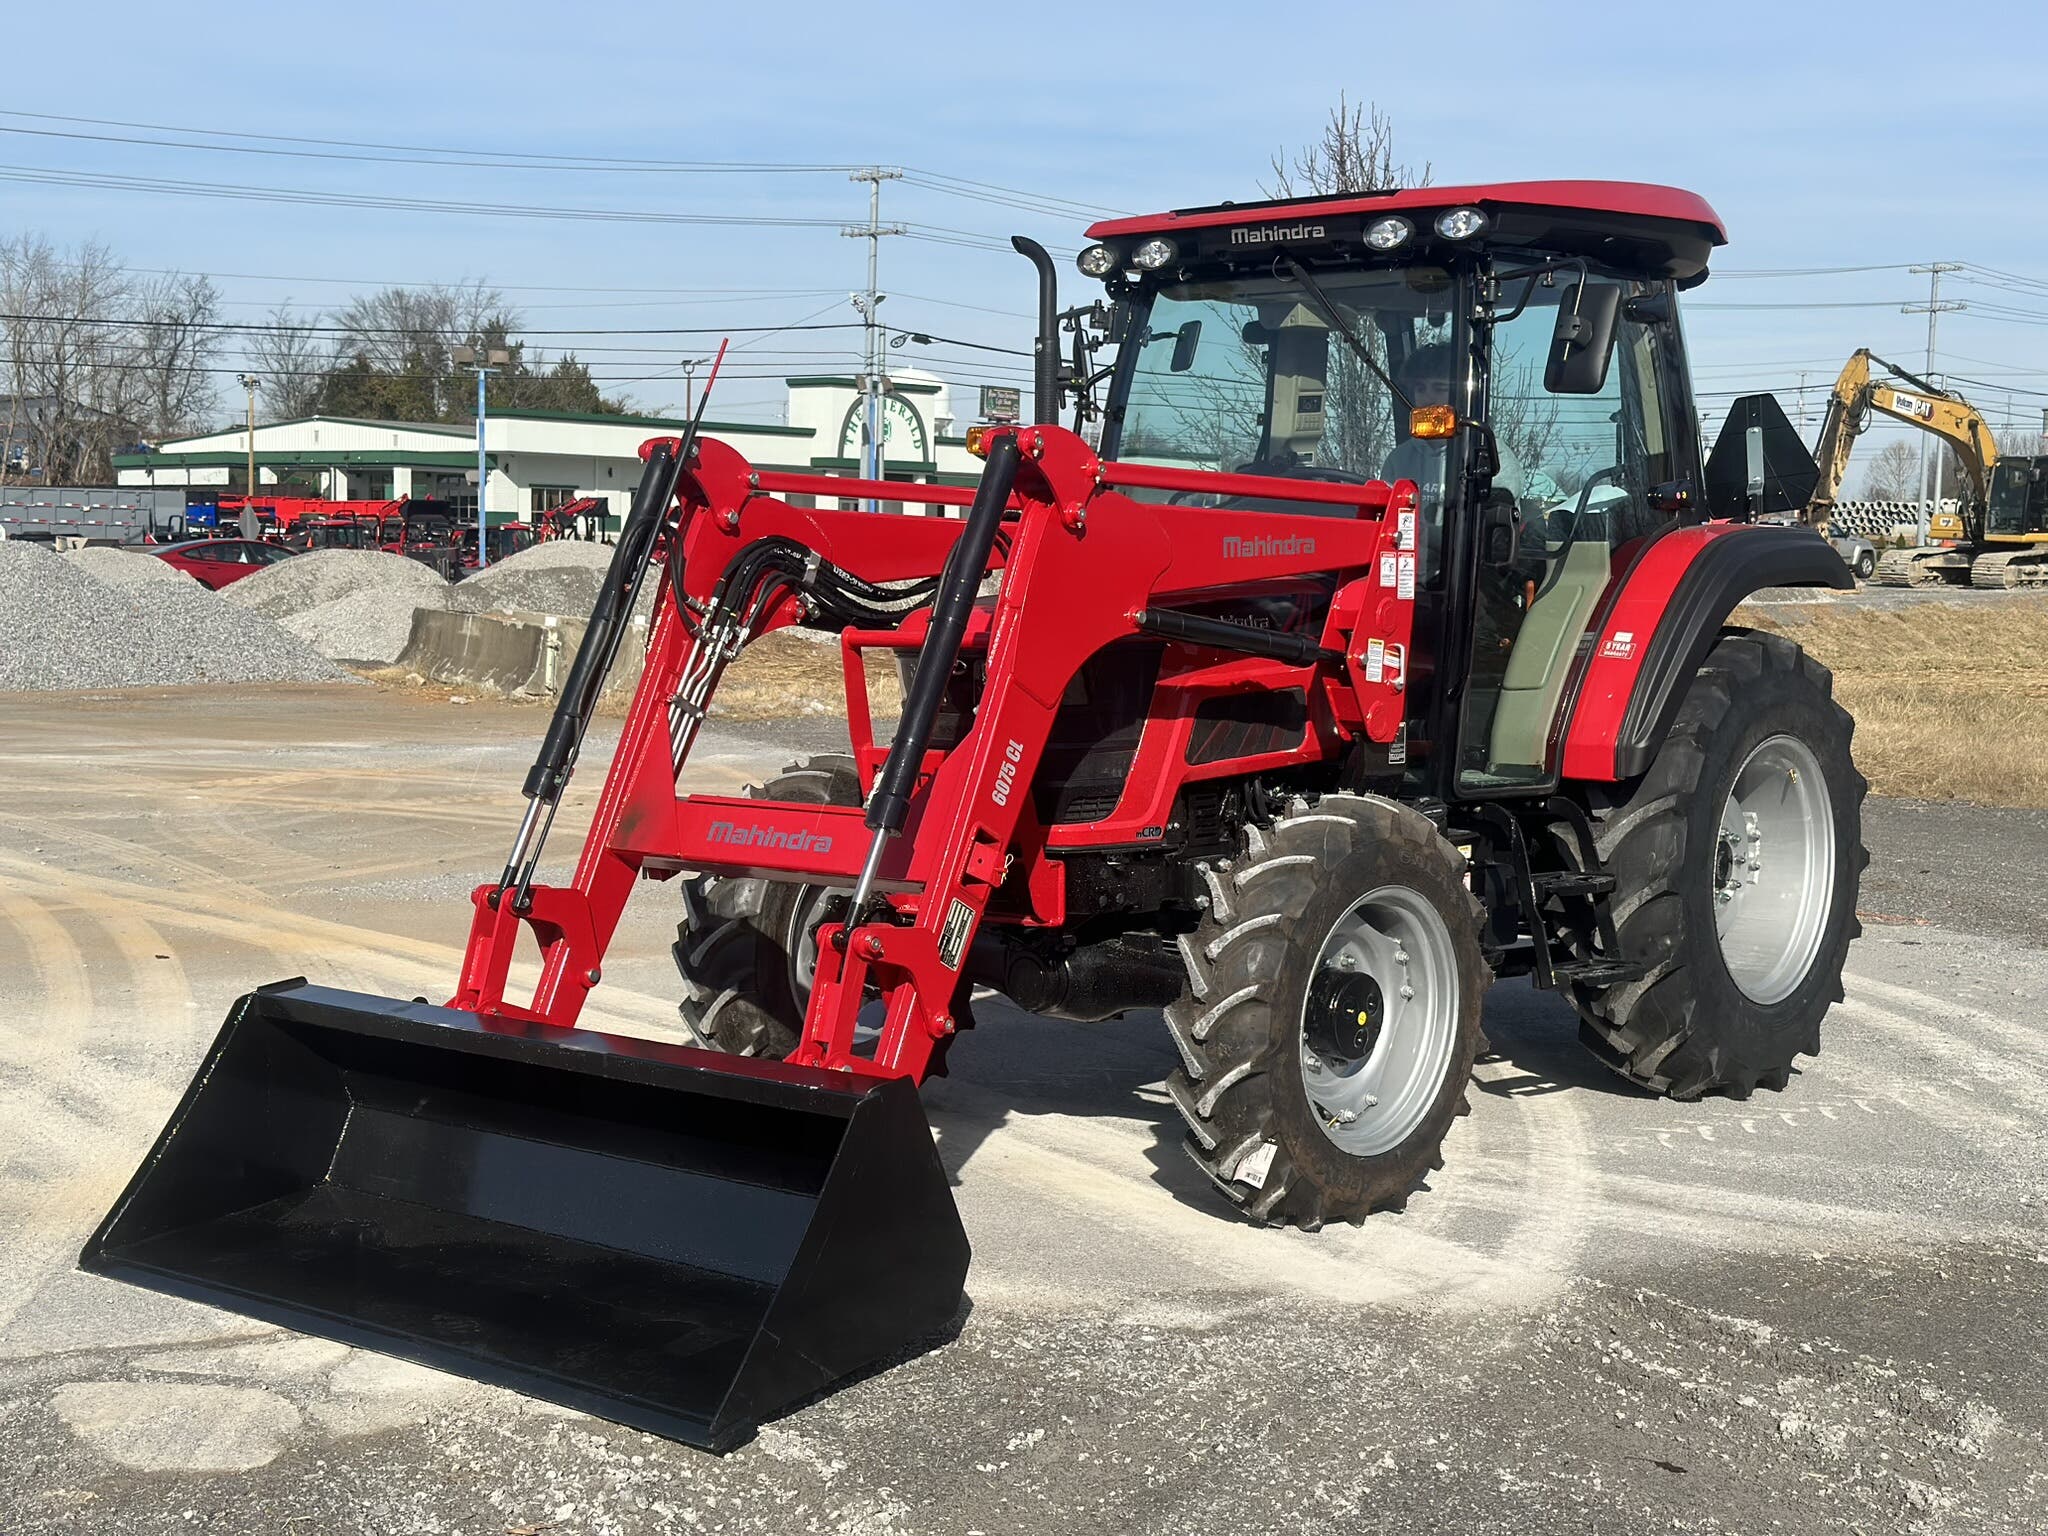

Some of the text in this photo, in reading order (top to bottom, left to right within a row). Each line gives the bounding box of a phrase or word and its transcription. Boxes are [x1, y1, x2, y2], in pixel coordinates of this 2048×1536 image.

[1231, 223, 1326, 244] Mahindra
[1915, 399, 1932, 417] CAT
[844, 408, 863, 446] THE
[1222, 533, 1316, 559] Mahindra
[991, 738, 1024, 807] 6075 CL
[706, 820, 833, 853] Mahindra
